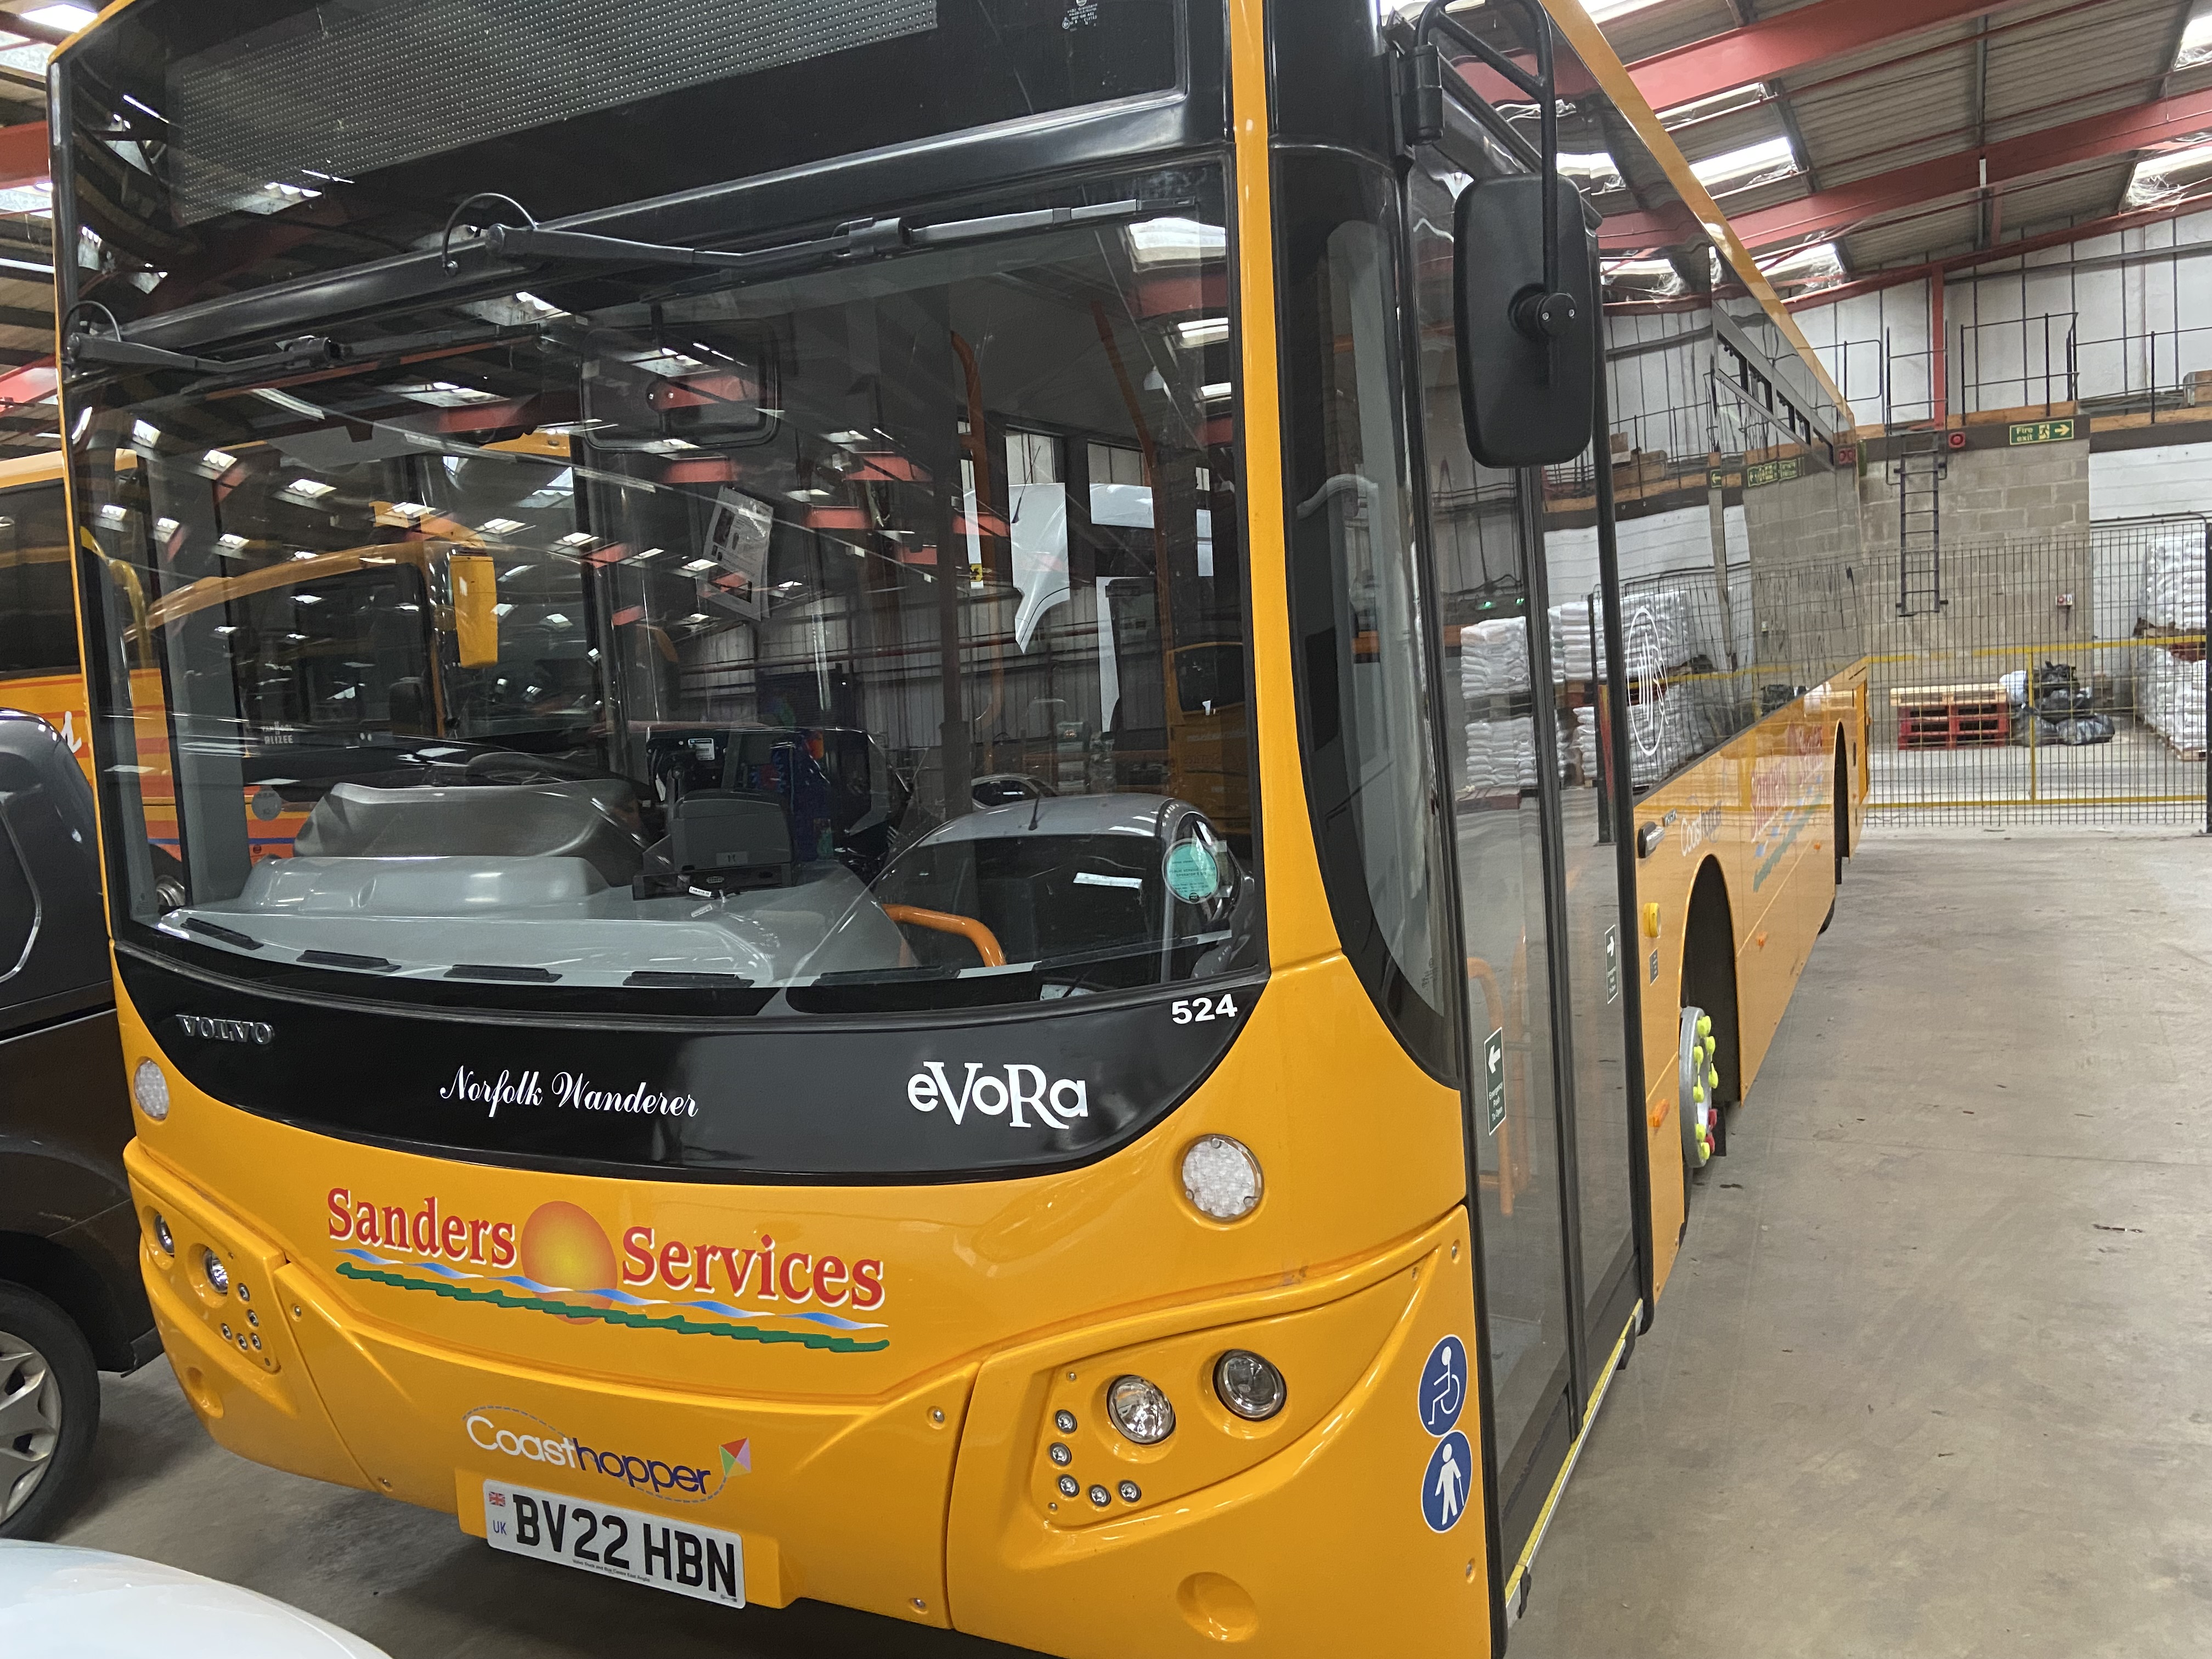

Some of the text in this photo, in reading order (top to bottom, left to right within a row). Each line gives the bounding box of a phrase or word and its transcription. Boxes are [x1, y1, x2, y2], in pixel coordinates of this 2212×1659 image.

[2017, 433, 2033, 443] exit
[176, 1014, 275, 1045] VOLVO
[1171, 994, 1238, 1024] 524
[439, 1065, 698, 1118] Norfolk Wanderer
[328, 1188, 886, 1310] Sanders Services
[466, 1415, 711, 1494] Coasthopper
[493, 1520, 507, 1536] UK
[513, 1494, 737, 1597] BV22 HBN
